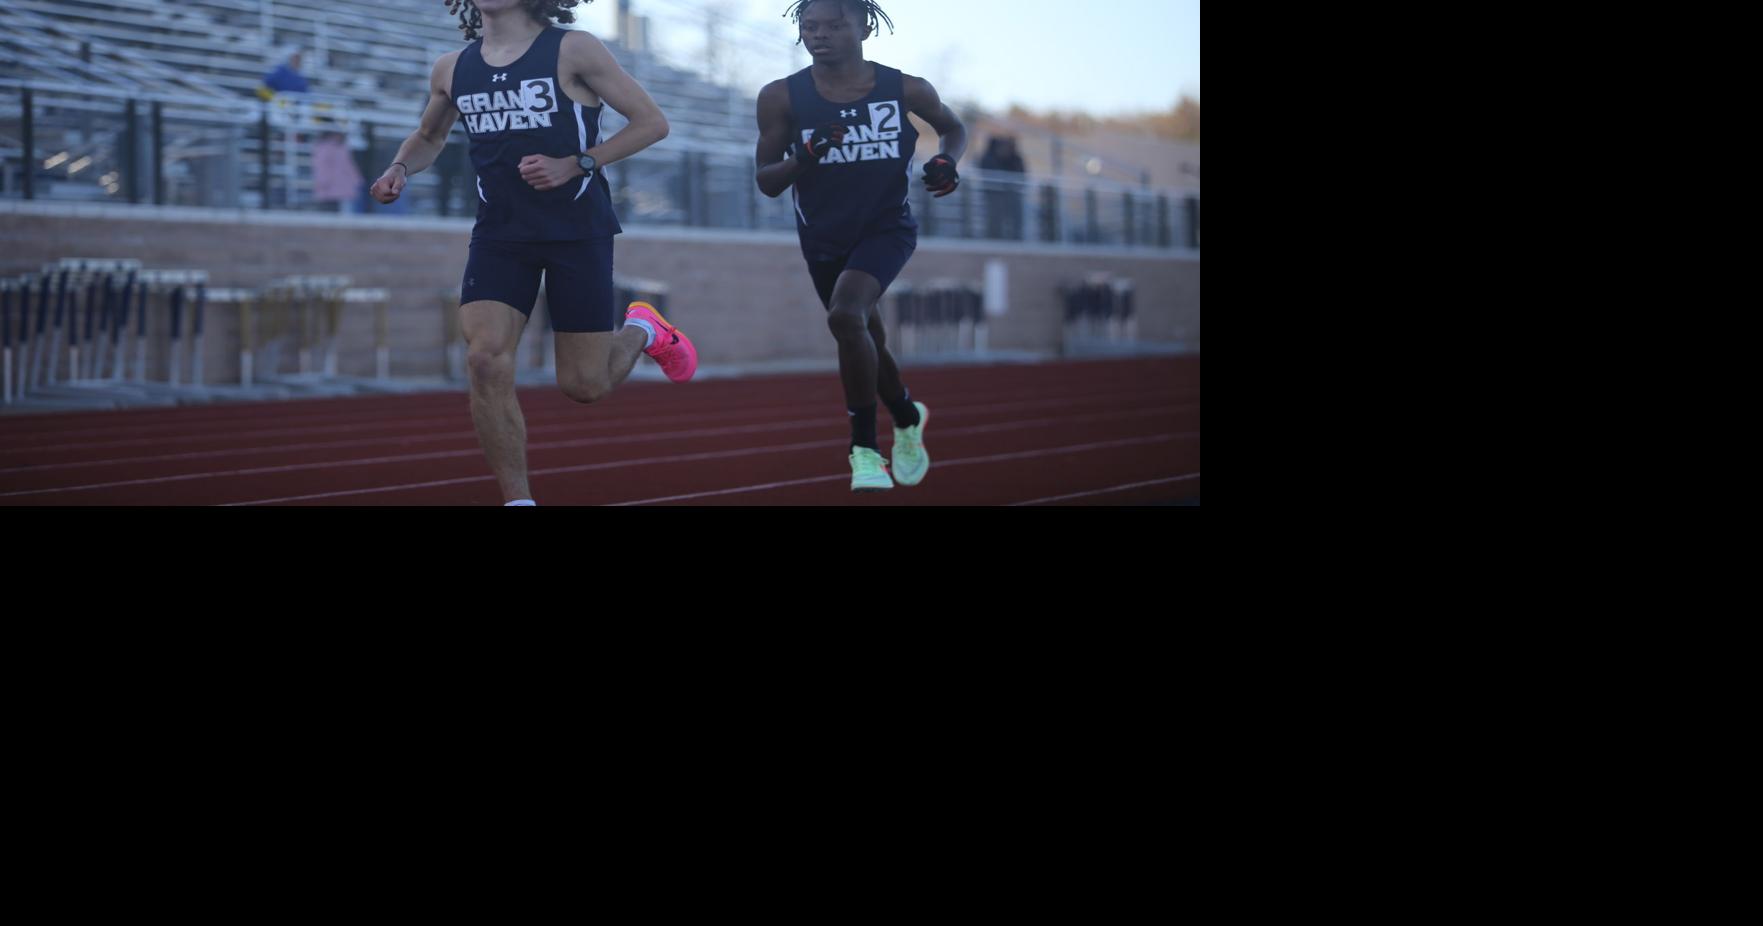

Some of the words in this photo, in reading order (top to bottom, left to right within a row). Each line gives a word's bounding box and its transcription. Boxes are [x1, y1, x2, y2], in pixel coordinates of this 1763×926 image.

[457, 90, 524, 114] GRAN
[527, 80, 553, 112] 3
[465, 110, 552, 133] HAVEN
[874, 103, 898, 132] 2
[819, 141, 900, 164] AVEN
